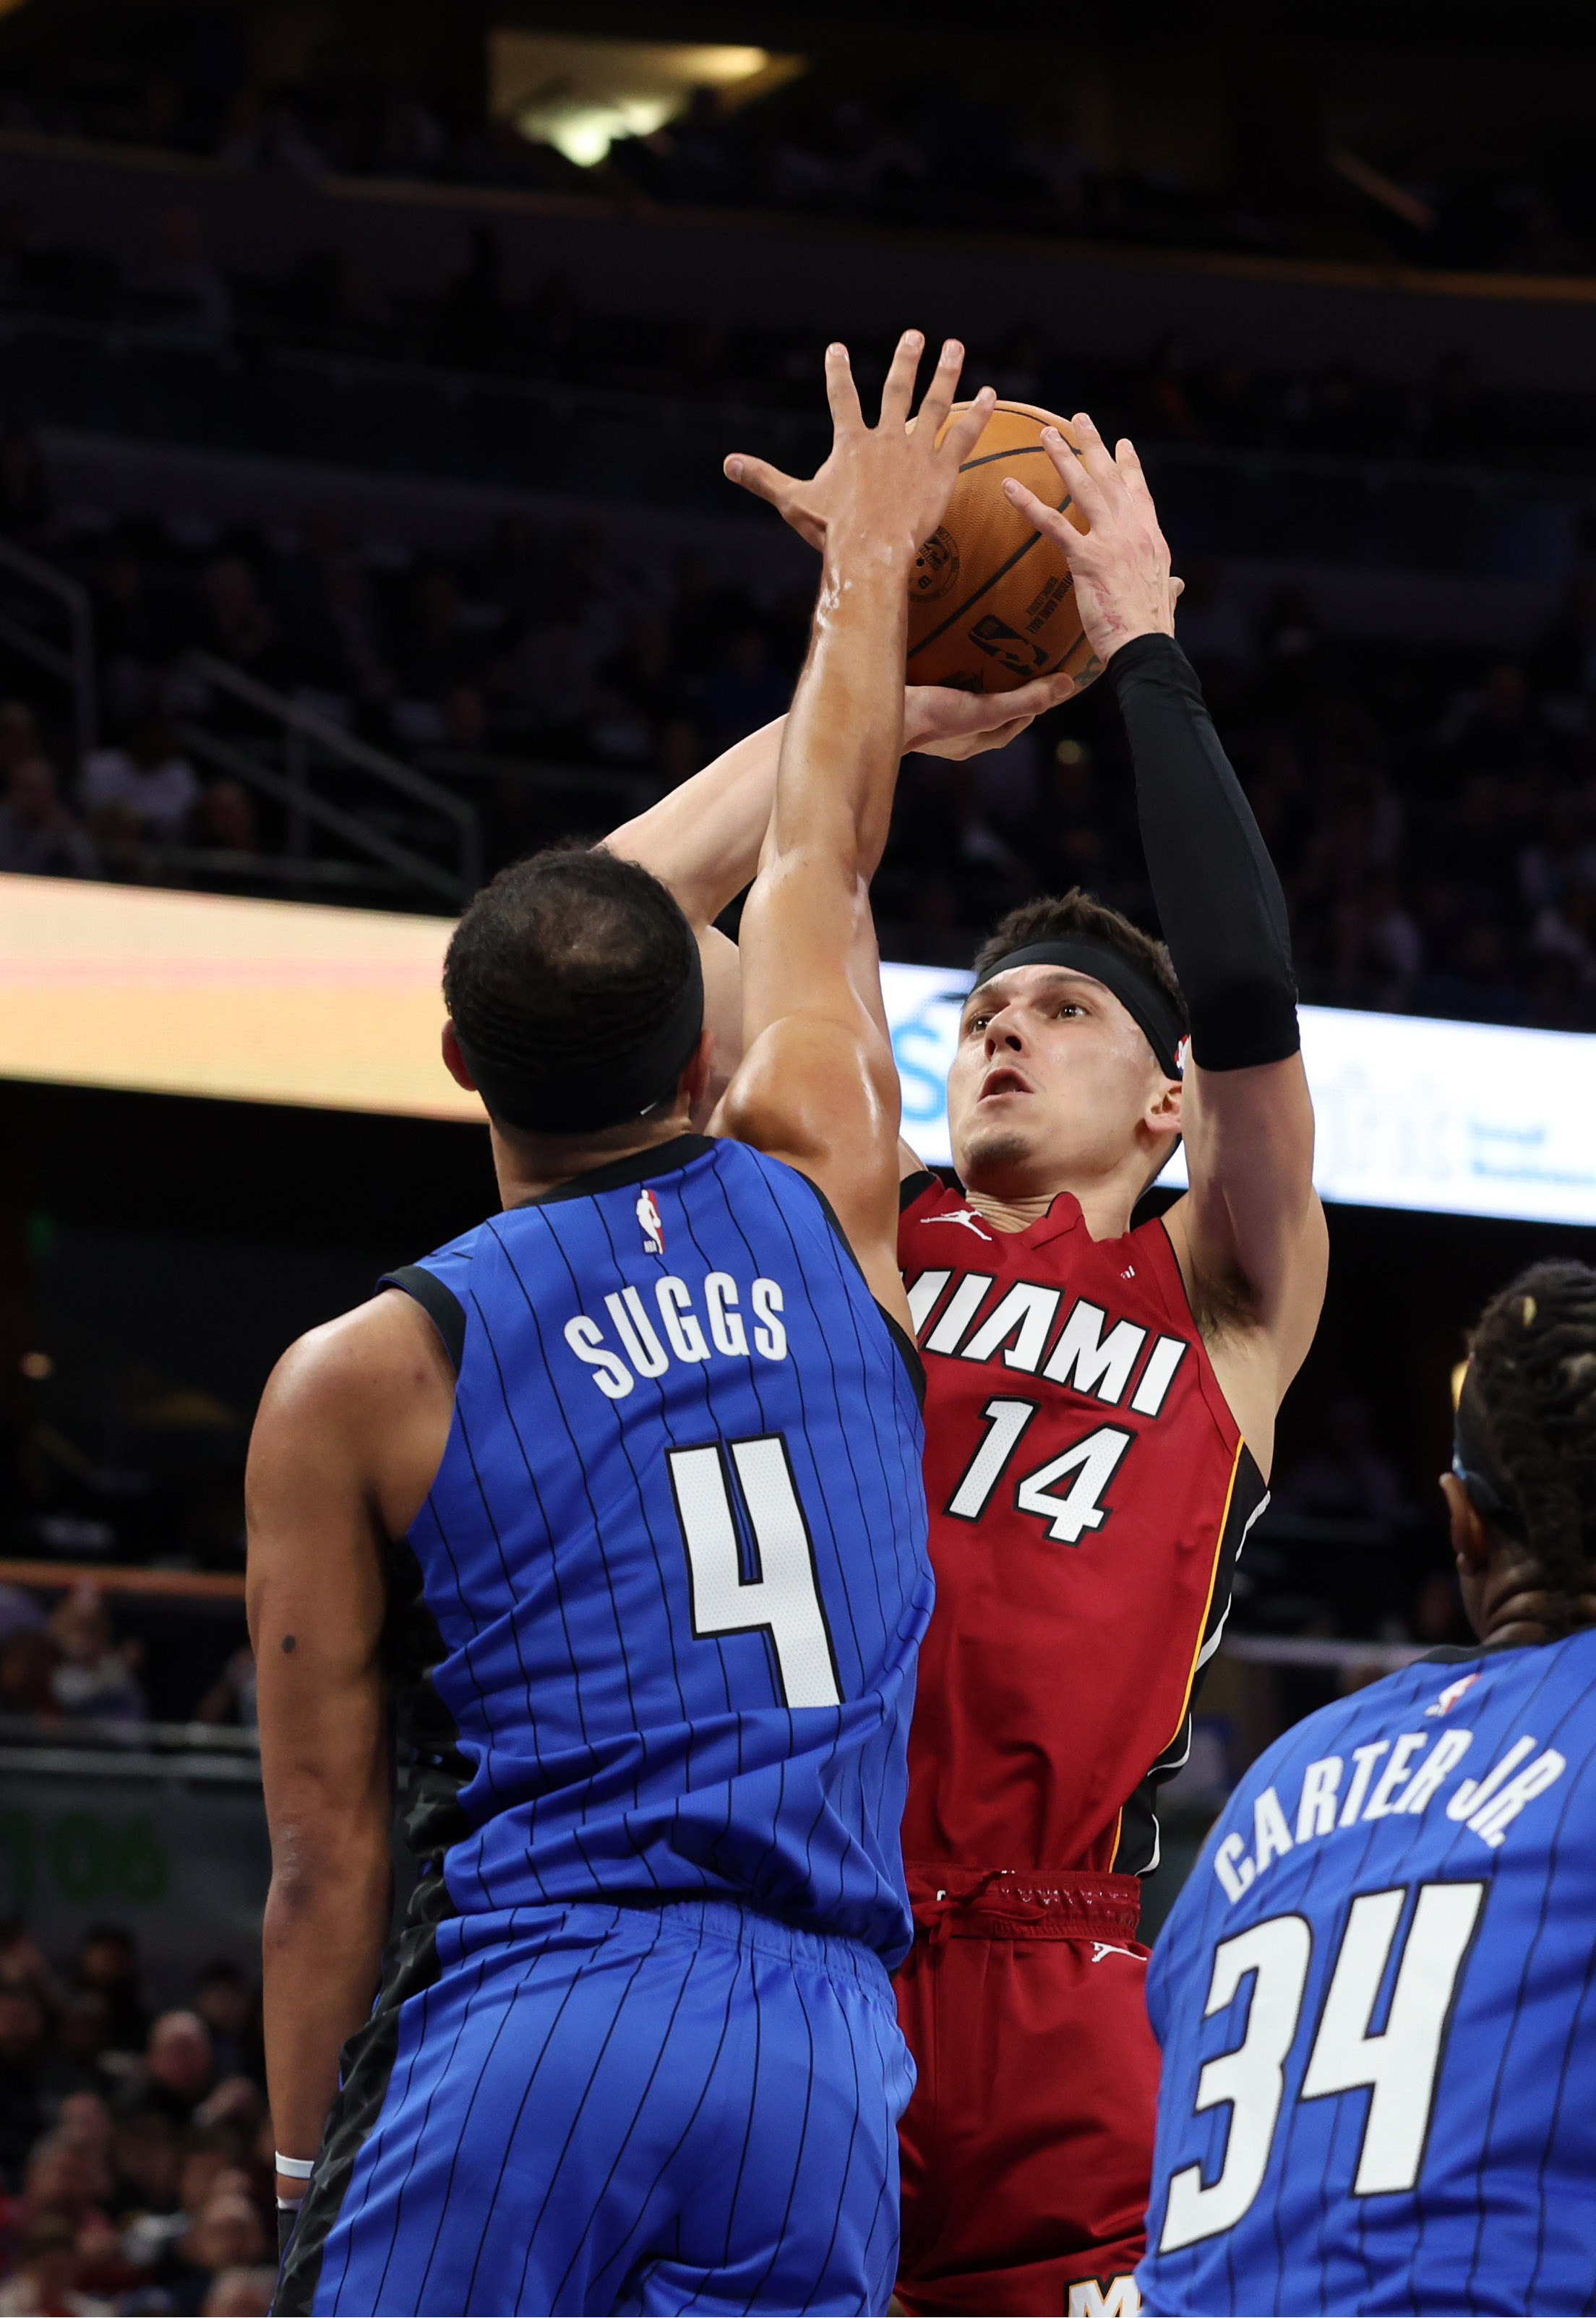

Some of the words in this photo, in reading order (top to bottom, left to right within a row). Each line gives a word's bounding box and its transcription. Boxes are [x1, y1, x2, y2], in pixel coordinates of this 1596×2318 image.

[563, 1271, 788, 1400] SUGGS
[943, 1394, 1138, 1548] 14
[664, 1430, 845, 1708] 4
[1214, 1728, 1474, 1905] CARTER
[1445, 1735, 1567, 1849] JR.
[1159, 1878, 1491, 2254] 34
